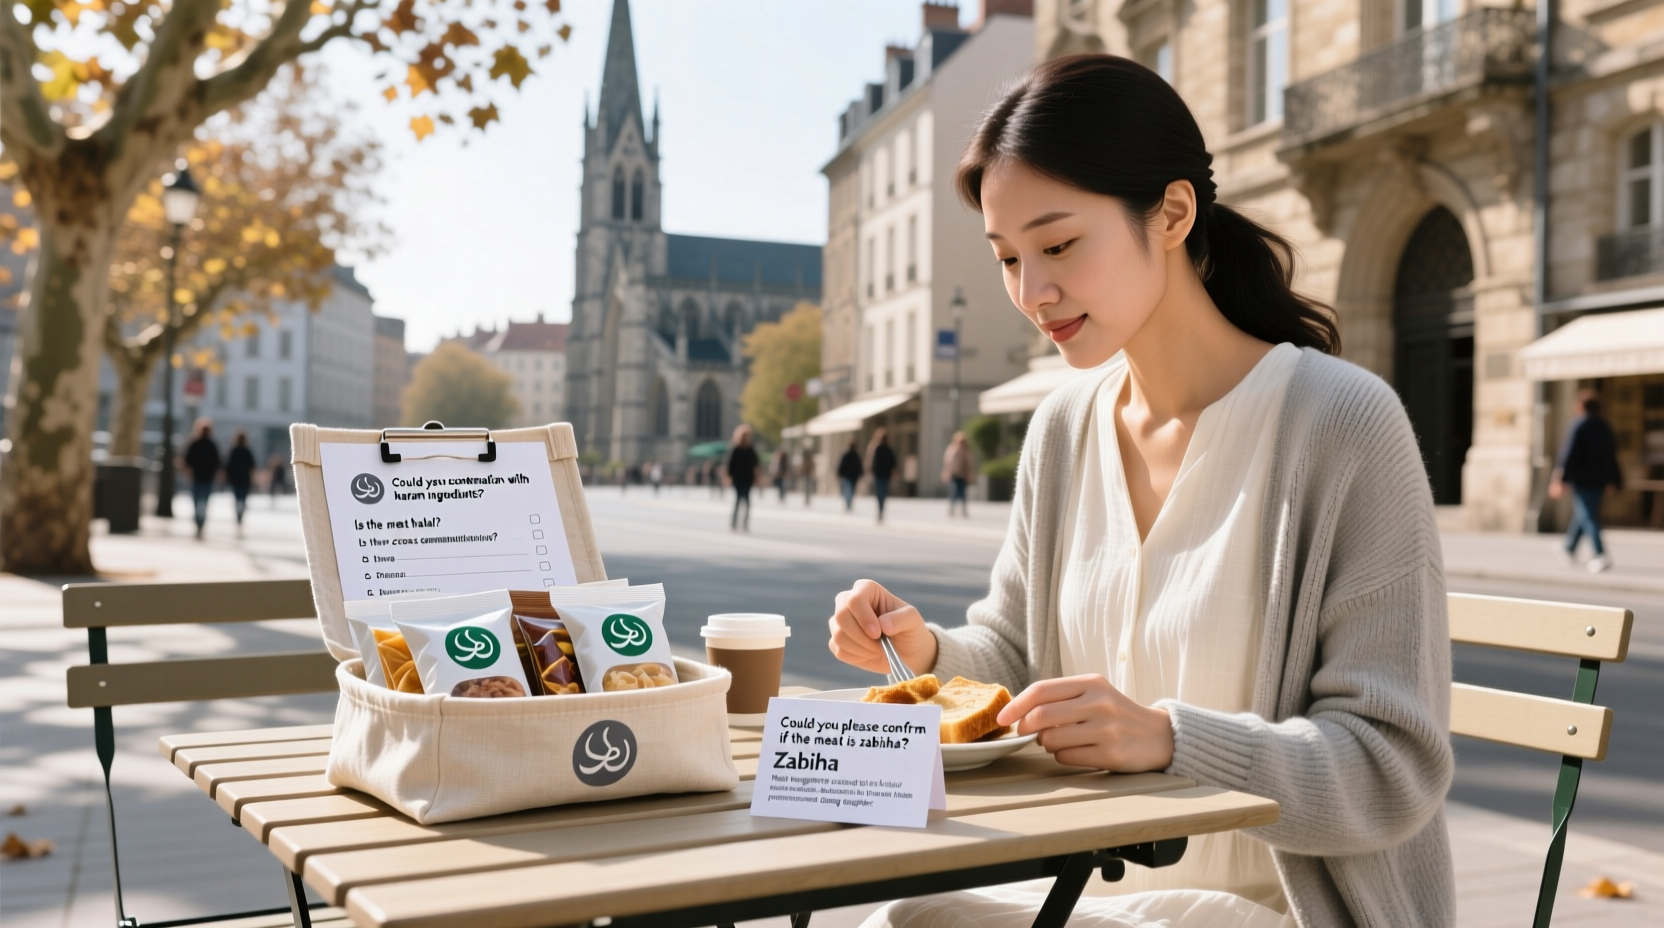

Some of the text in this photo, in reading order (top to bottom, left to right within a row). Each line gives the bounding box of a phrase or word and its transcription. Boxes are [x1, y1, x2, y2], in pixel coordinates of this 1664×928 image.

[391, 476, 423, 487] Could
[354, 519, 364, 530] Is
[366, 519, 383, 530] the
[411, 517, 441, 528] halal?
[780, 716, 815, 729] Could
[817, 721, 839, 733] you
[841, 719, 880, 735] please
[779, 731, 789, 744] if
[791, 733, 811, 745] the
[814, 736, 843, 747] meat
[847, 735, 856, 747] is
[773, 751, 839, 772] Zabiha
